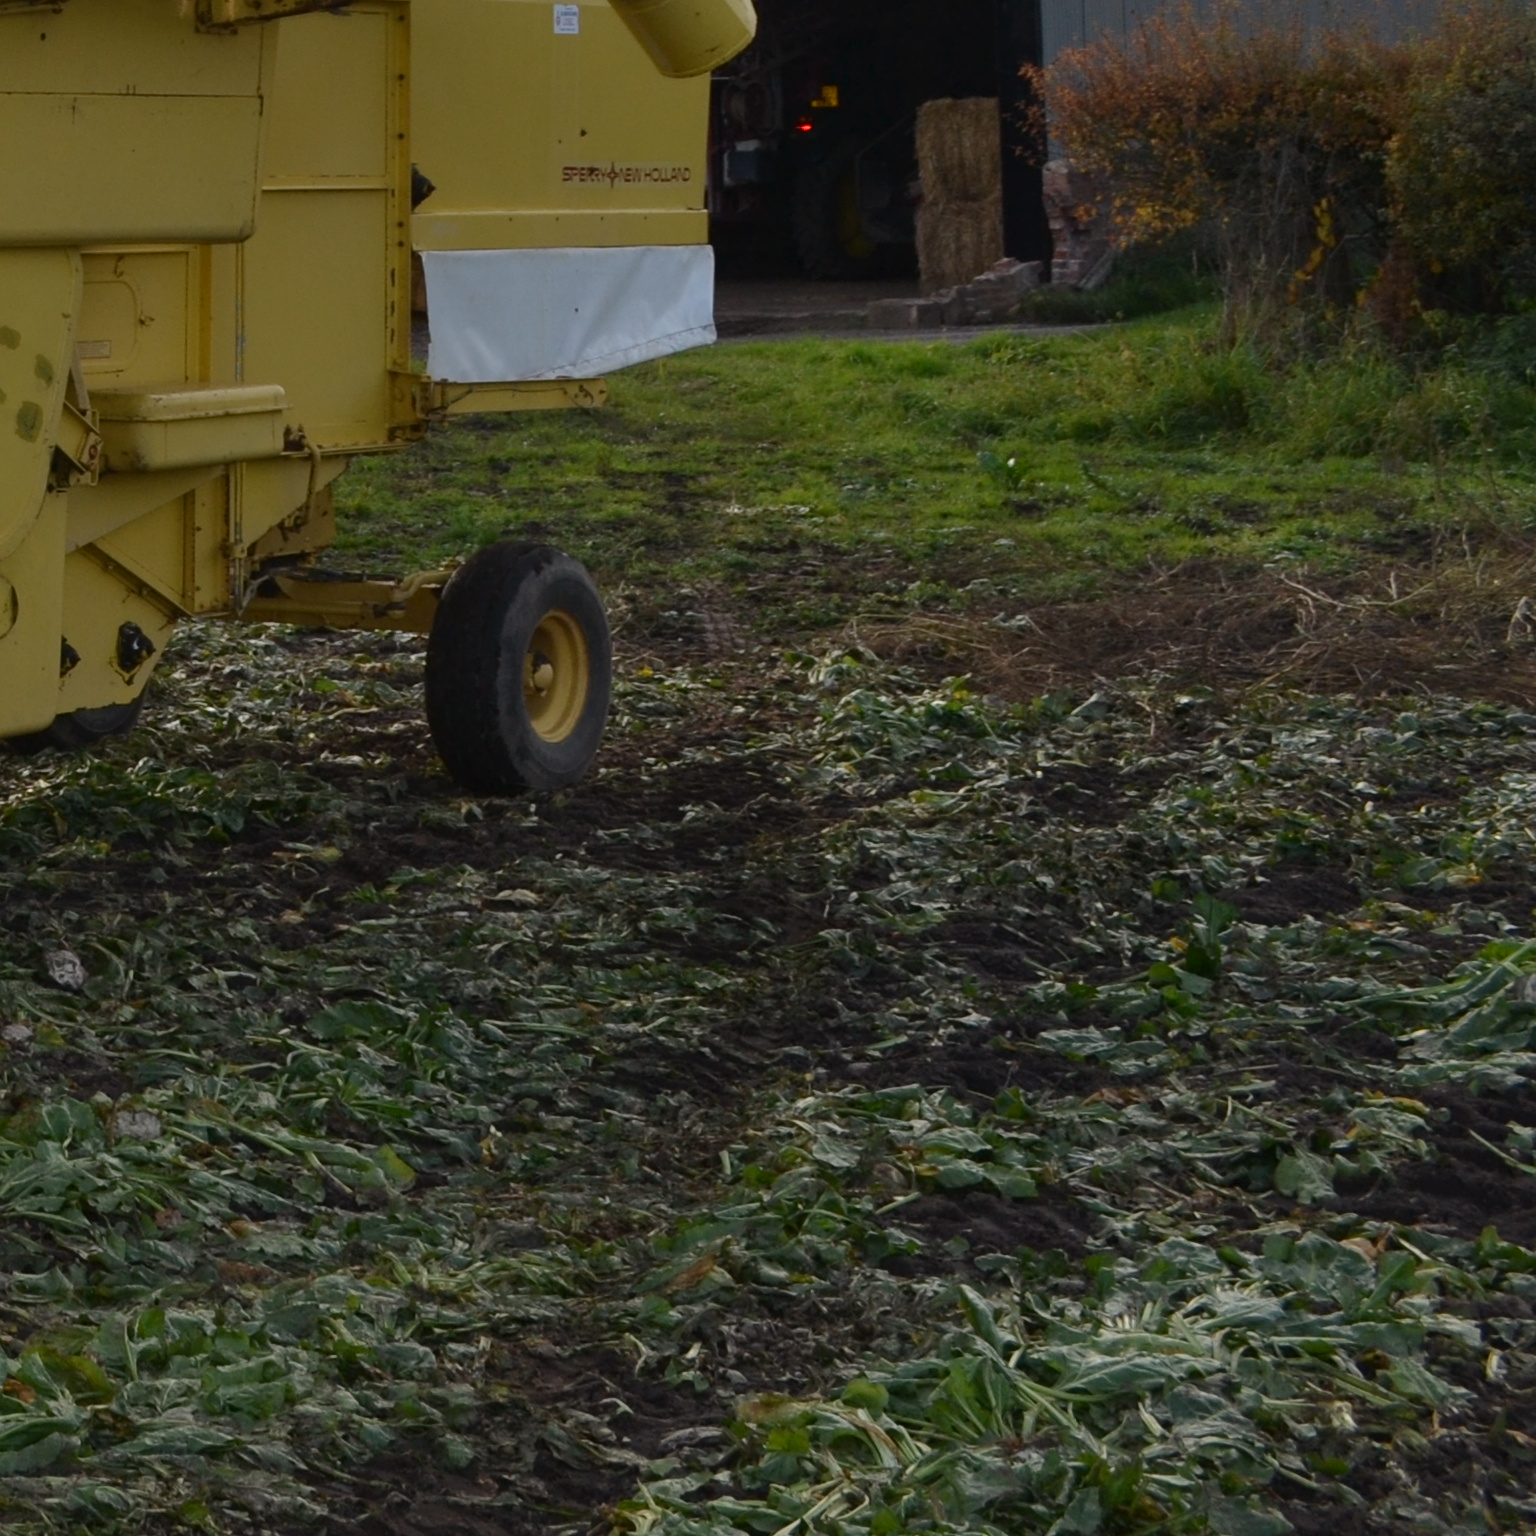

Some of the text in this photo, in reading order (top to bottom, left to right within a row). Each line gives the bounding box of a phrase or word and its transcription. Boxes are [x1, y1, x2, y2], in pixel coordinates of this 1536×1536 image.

[562, 166, 691, 182] SPERRY NEW HOLLAND
